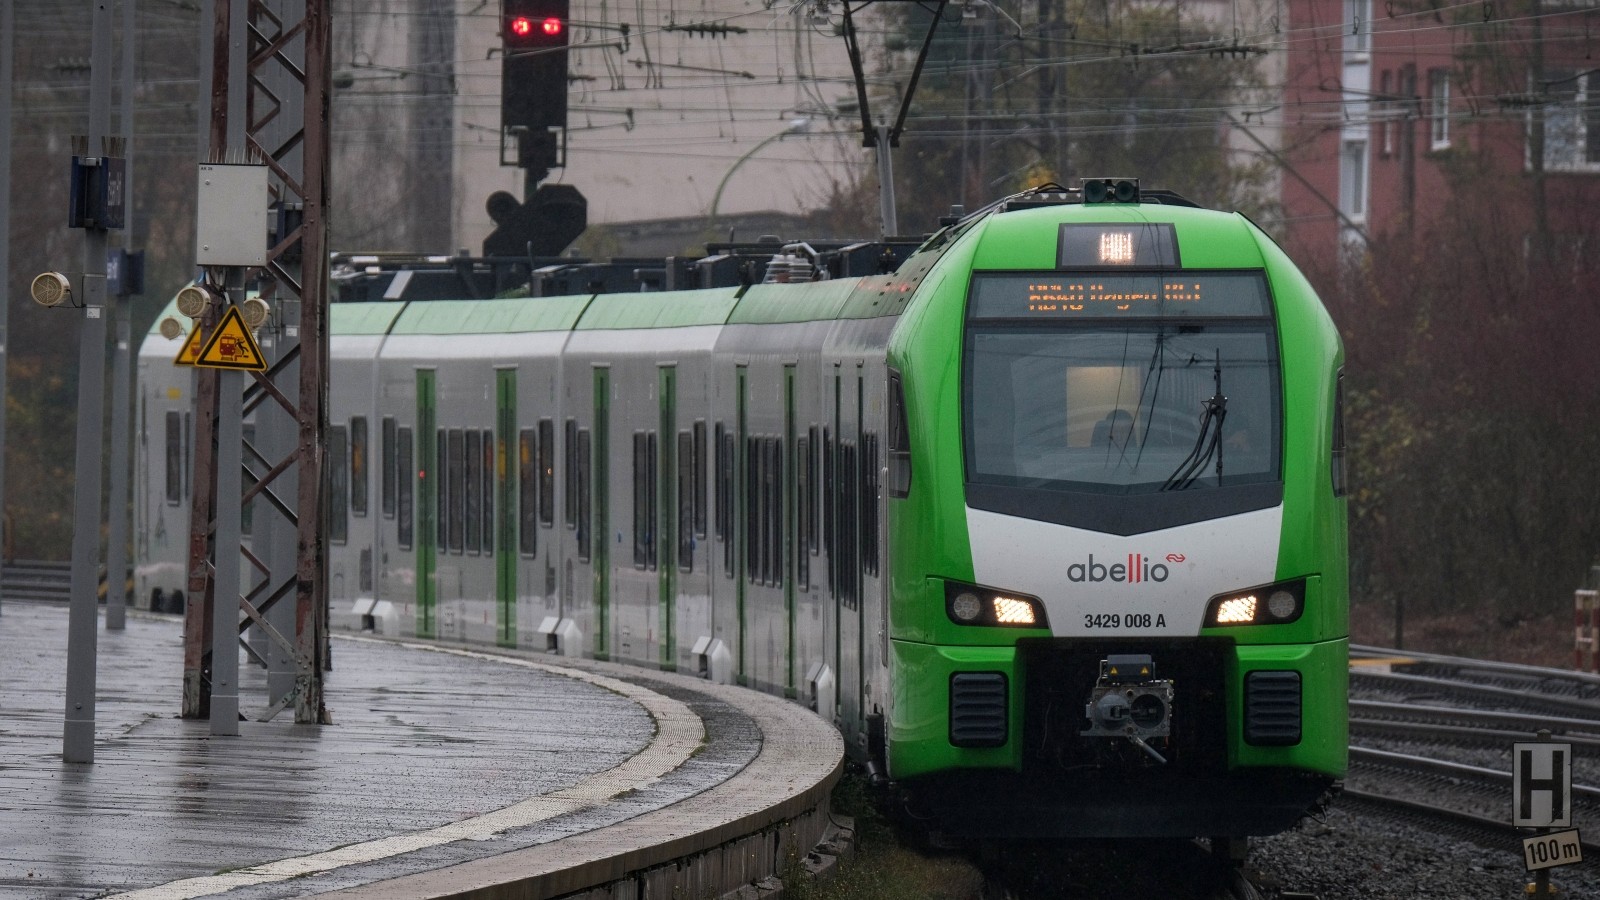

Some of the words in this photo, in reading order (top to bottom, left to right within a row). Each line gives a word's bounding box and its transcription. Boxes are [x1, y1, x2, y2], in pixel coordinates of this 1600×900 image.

[1067, 553, 1169, 583] abellio
[1084, 613, 1121, 629] 3429
[1124, 613, 1152, 629] 008
[1155, 613, 1167, 628] A
[1520, 750, 1564, 820] H
[1527, 839, 1560, 865] 100
[1562, 841, 1578, 859] m
